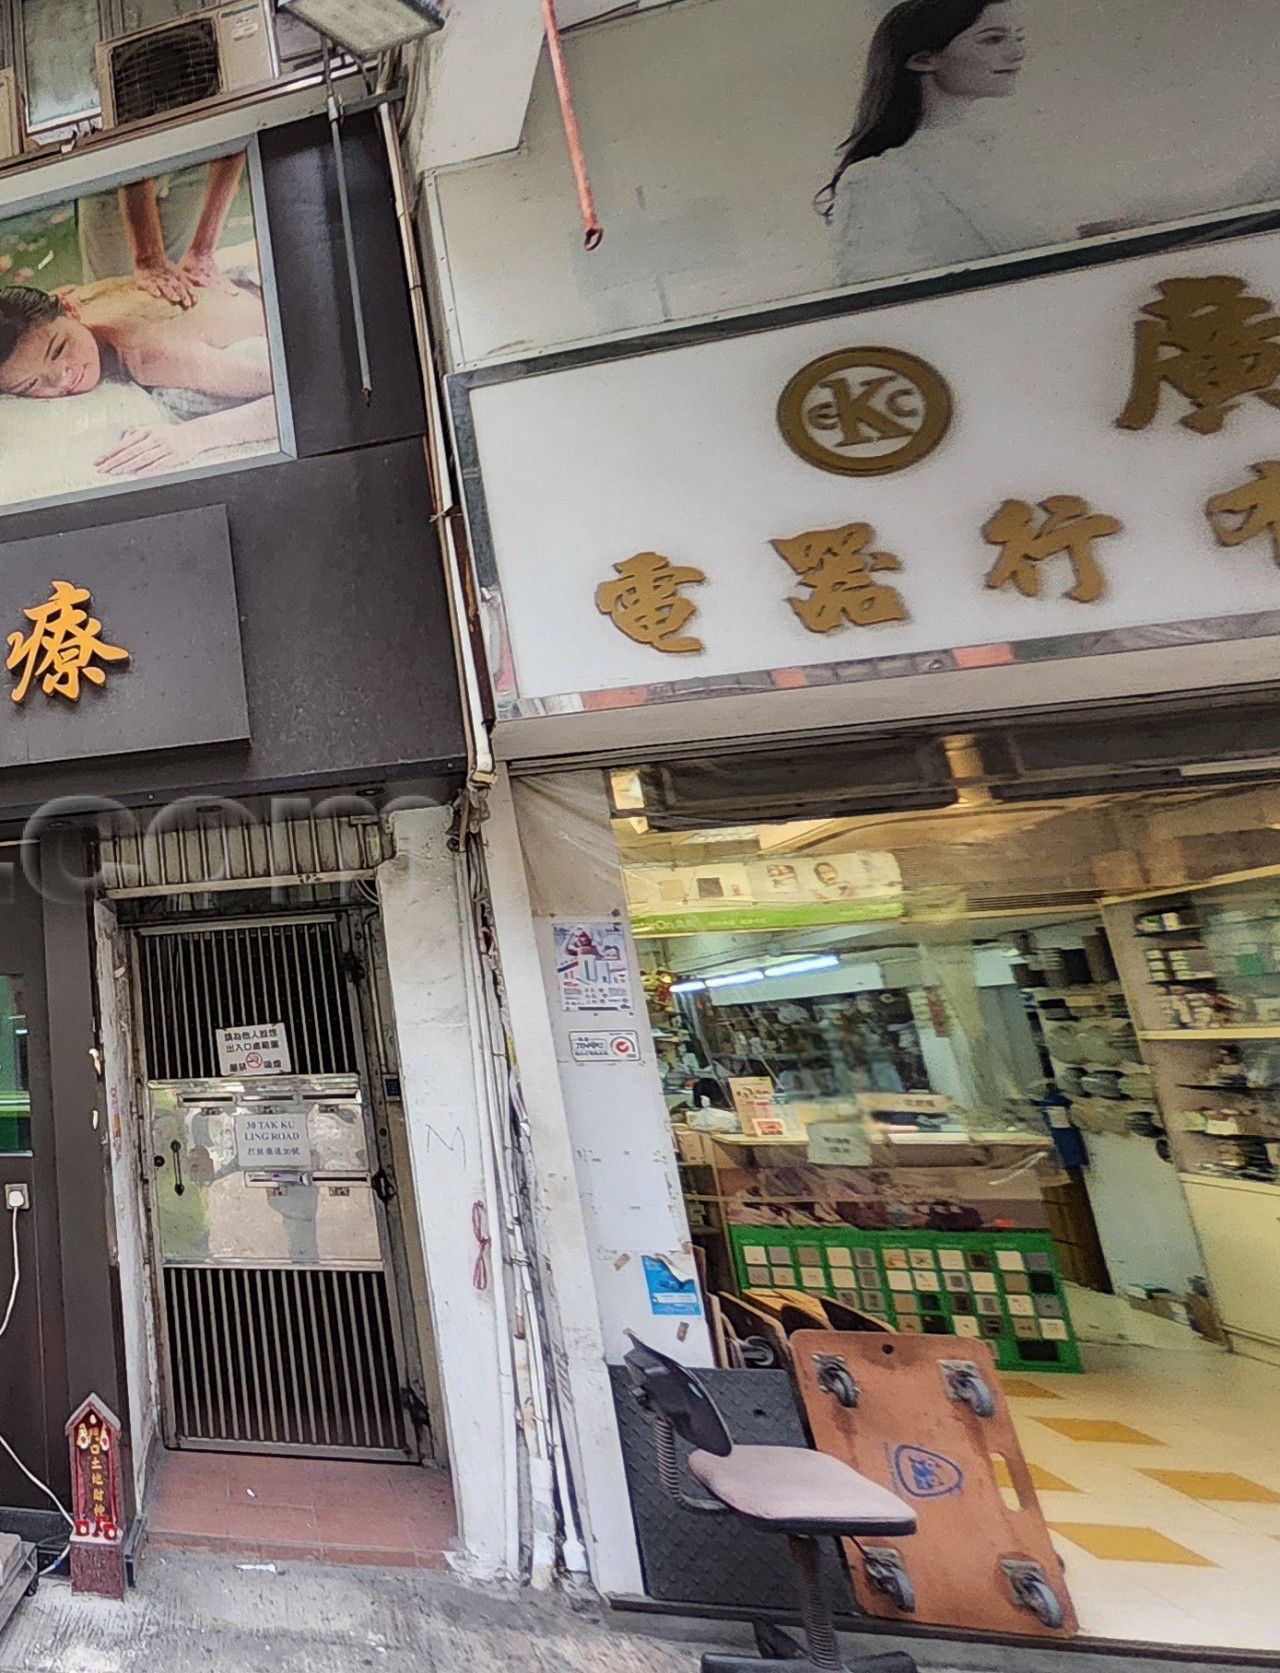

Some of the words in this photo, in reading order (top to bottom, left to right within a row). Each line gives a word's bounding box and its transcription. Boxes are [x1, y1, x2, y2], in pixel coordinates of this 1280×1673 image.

[258, 1121, 279, 1130] TAK
[281, 1121, 296, 1129] KU
[244, 1133, 270, 1141] LING
[271, 1131, 300, 1141] ROAD
